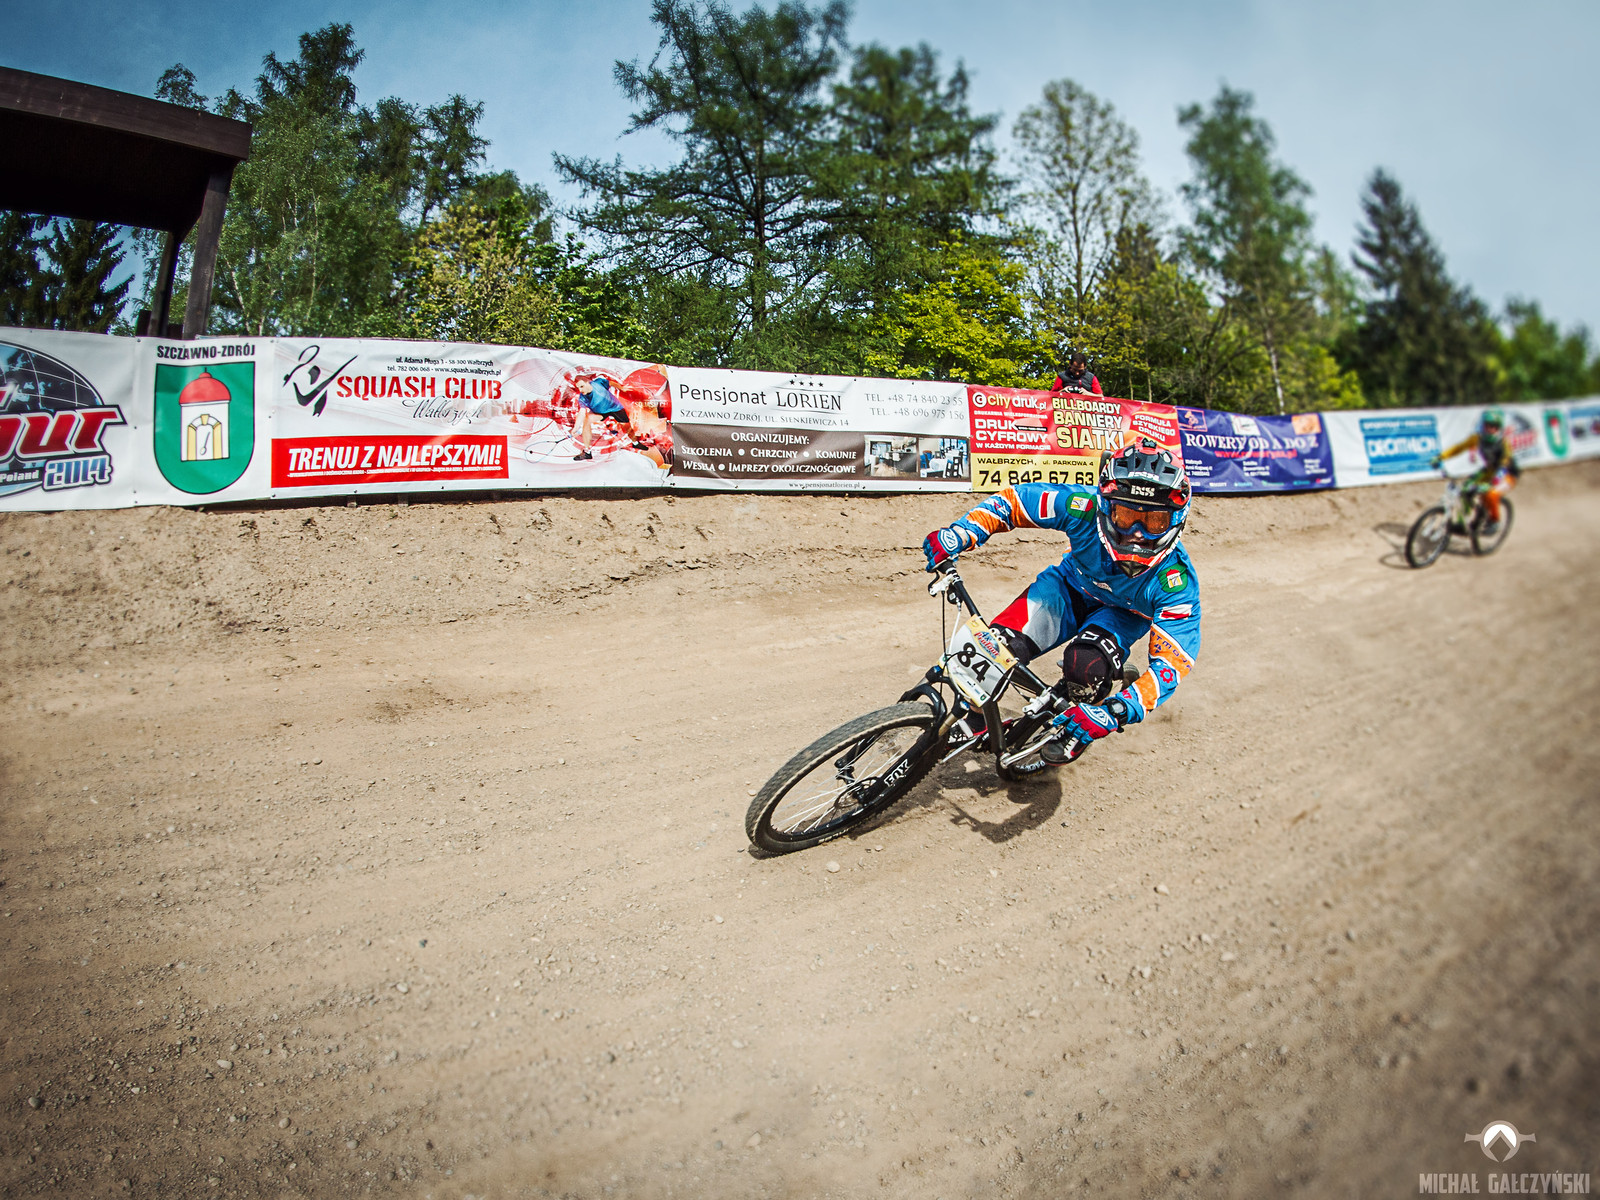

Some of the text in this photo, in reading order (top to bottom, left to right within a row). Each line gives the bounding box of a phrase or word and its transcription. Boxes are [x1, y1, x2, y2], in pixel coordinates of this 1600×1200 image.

[156, 342, 256, 360] SZCZAWNO-ZDRÓJ
[404, 356, 424, 365] Adama
[336, 375, 502, 400] SQUASH CLUB
[679, 383, 842, 411] Pensjonat LORIEN
[888, 393, 904, 402] +48
[906, 394, 918, 403] 74
[921, 394, 938, 404] 840
[941, 395, 950, 405] 23
[1051, 397, 1121, 415] BILLBOARDY
[894, 407, 910, 416] +48
[912, 408, 929, 418] 696
[931, 408, 946, 419] 975
[949, 410, 965, 420] 156
[1053, 410, 1123, 429] BANNERY
[974, 418, 1018, 431] DRUK
[730, 431, 810, 446] ORGANIZUJEMY:
[975, 430, 1049, 443] CYFROWY
[1055, 426, 1125, 451] SIATKI
[1184, 432, 1247, 450] ROWERY
[1247, 437, 1270, 450] OD
[1271, 436, 1283, 450] A
[1284, 436, 1307, 450] DO
[287, 444, 503, 471] TRENUJ Z NAJLEPSZYMI!
[1053, 459, 1087, 467] PARKOWA
[45, 456, 109, 488] 2014
[978, 470, 1094, 486] 74 842 67 63
[957, 642, 992, 683] 84
